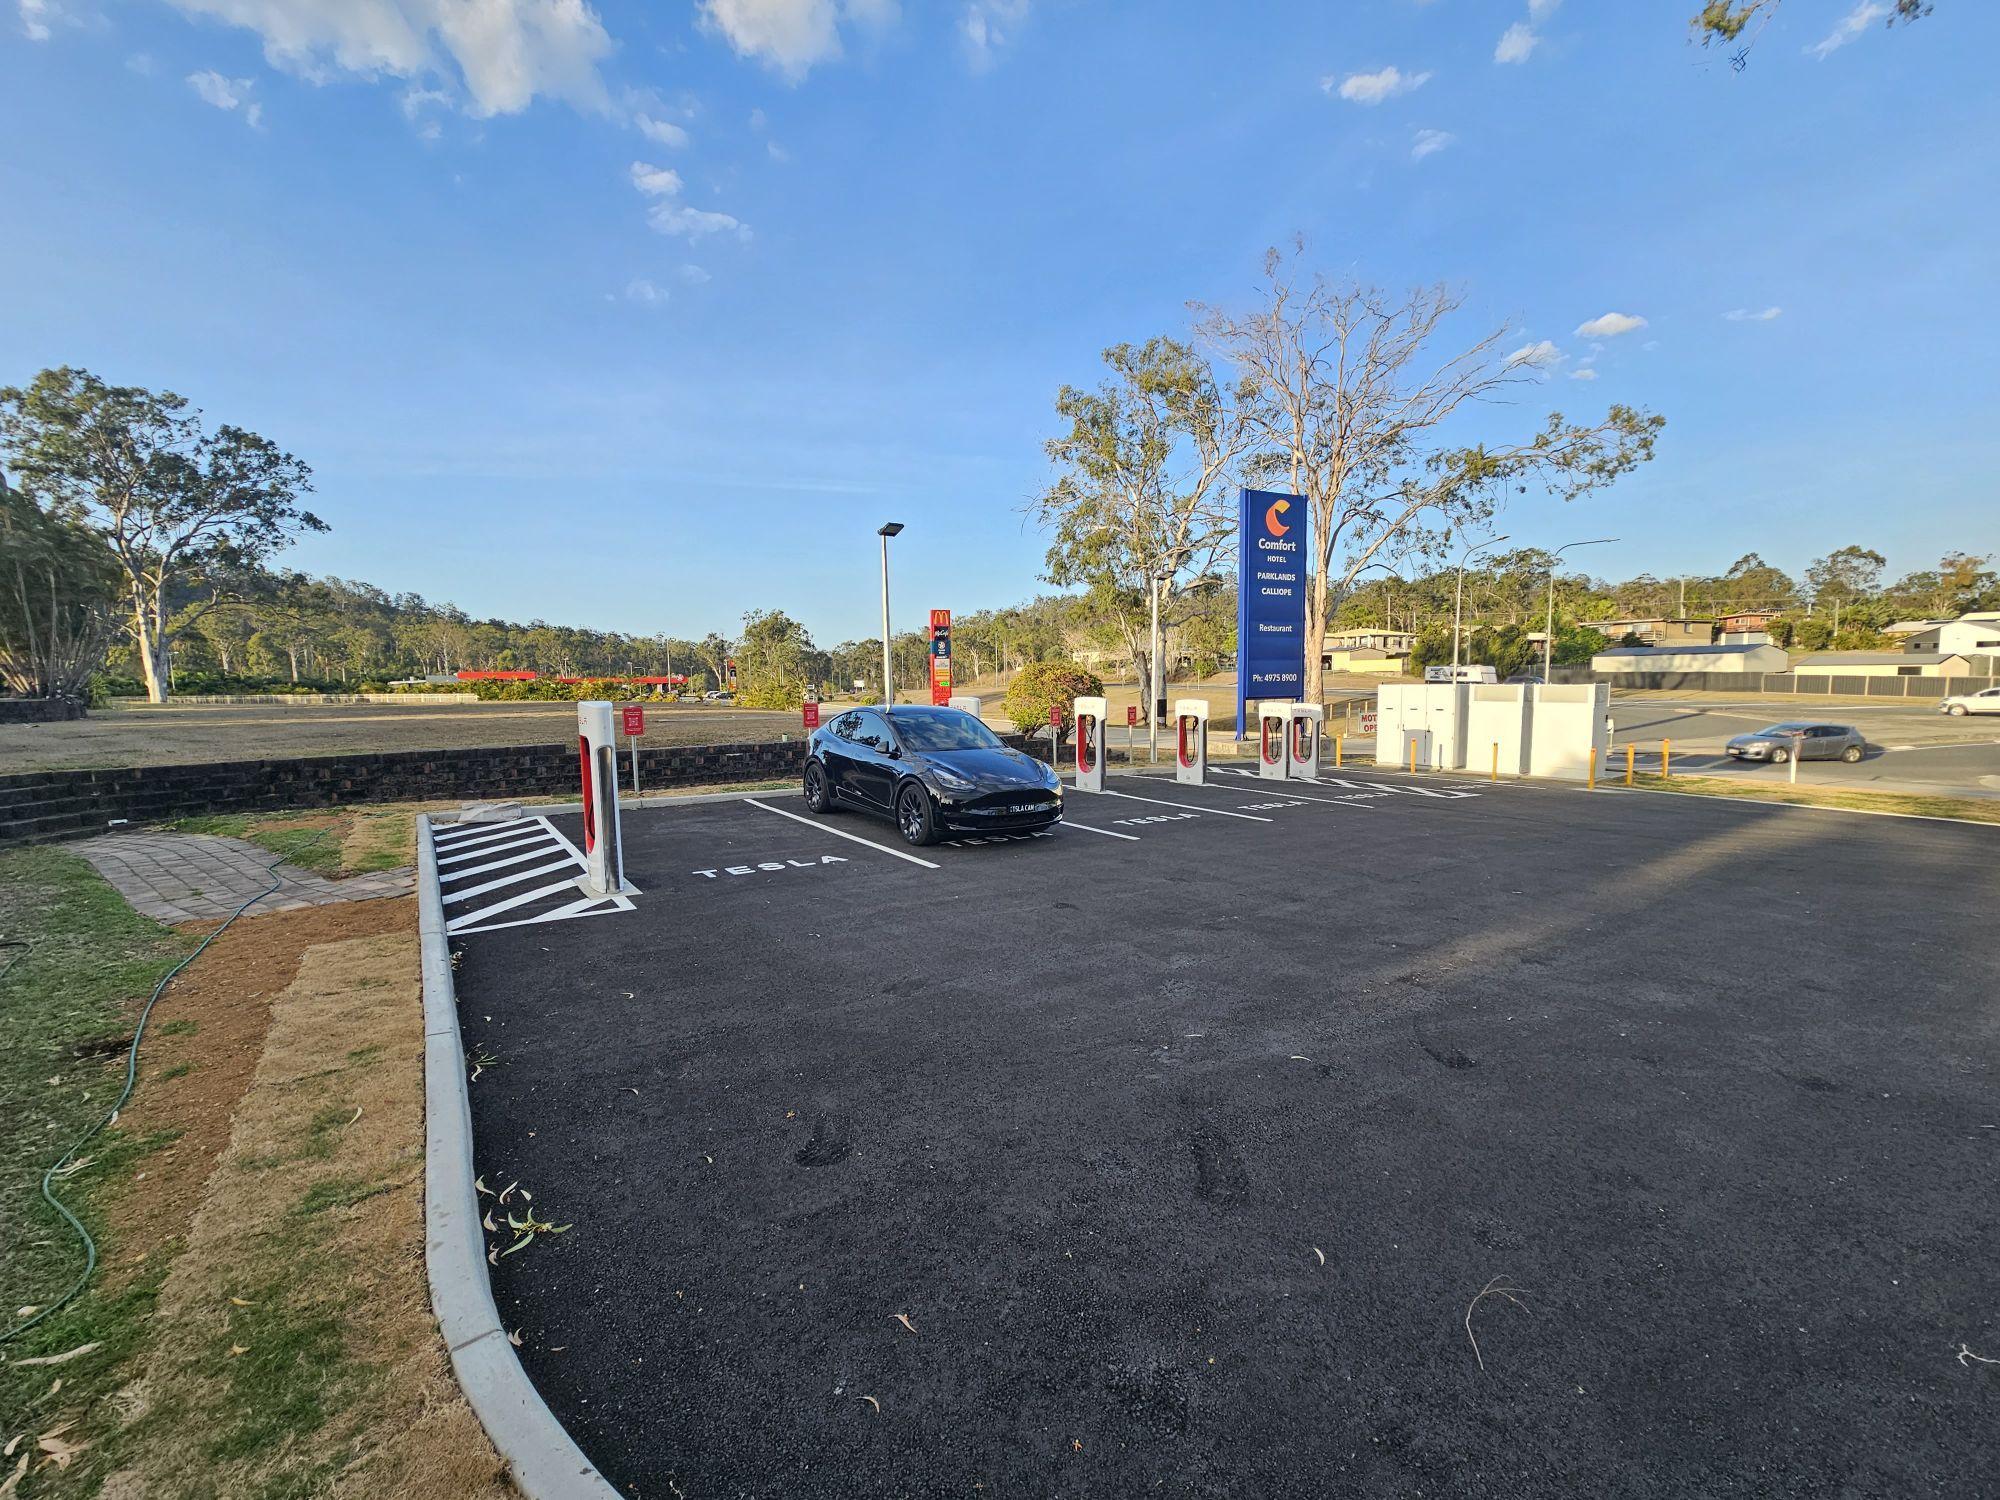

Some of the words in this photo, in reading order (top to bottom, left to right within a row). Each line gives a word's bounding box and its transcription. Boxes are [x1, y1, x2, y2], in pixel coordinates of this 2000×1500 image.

[1258, 538, 1296, 551] Comfort
[1257, 572, 1296, 581] PARKLANDS
[1261, 588, 1292, 596] CALLIOPE
[1259, 624, 1292, 632] Restaurant
[1252, 674, 1263, 682] Ph:
[1113, 813, 1200, 826] TESLA
[941, 832, 1054, 847] TESLA
[692, 855, 849, 878] TESLA
